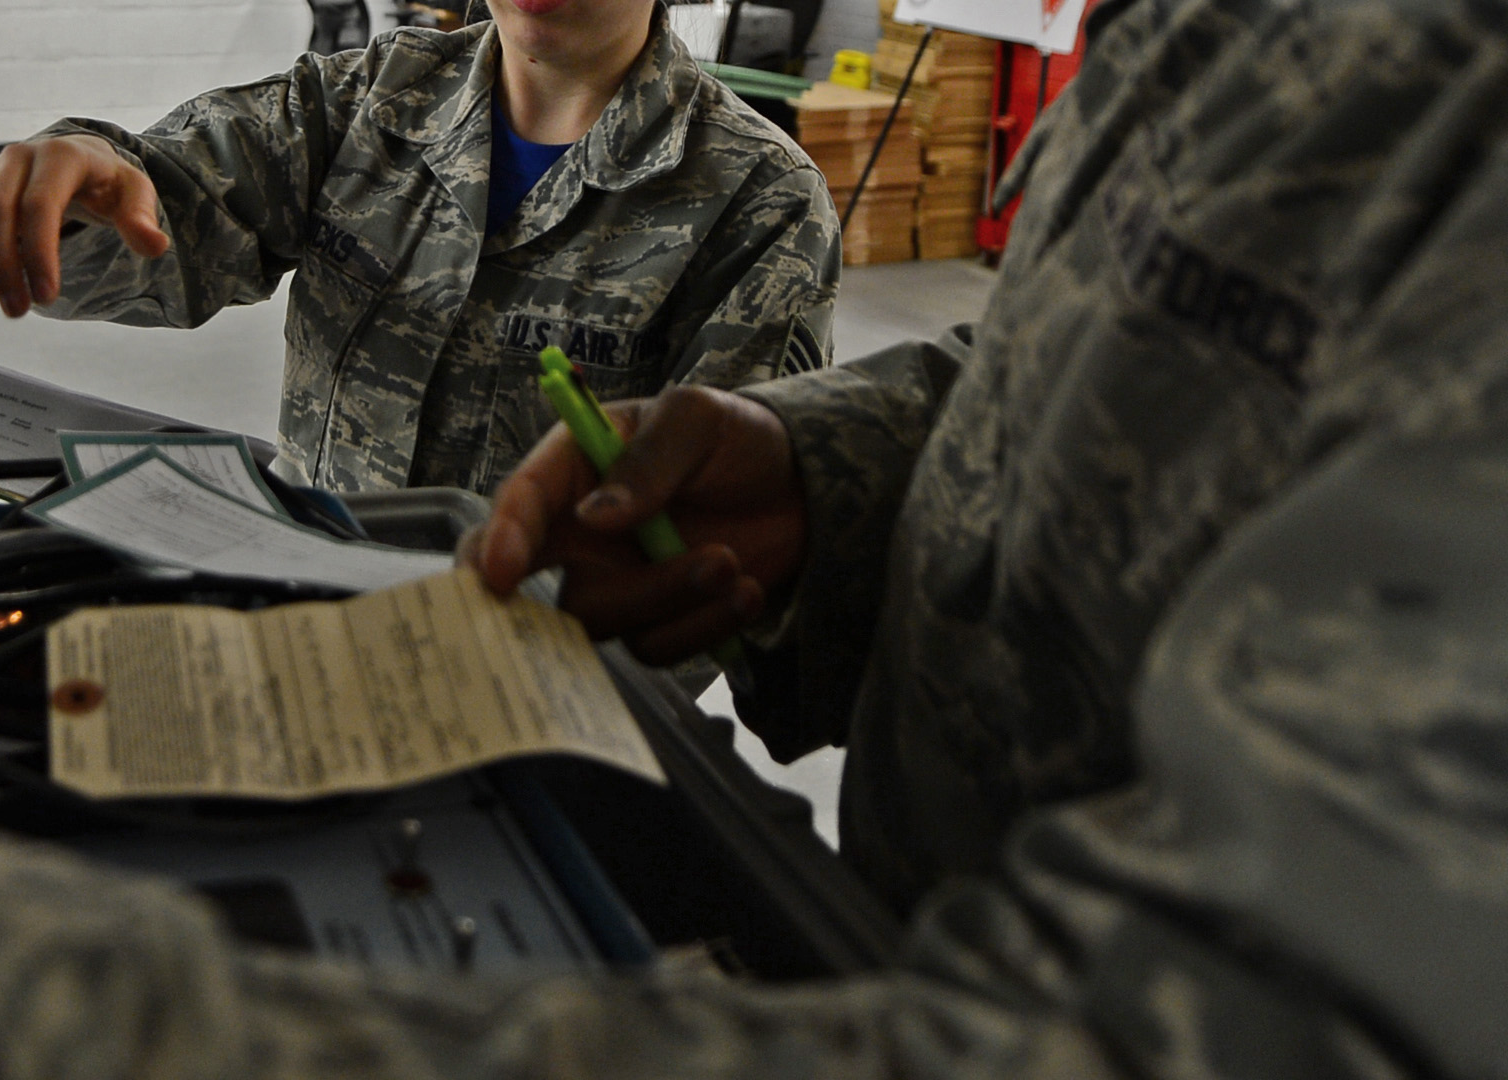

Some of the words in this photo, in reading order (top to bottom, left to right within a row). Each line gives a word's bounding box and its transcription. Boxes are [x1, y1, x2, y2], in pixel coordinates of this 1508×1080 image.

[309, 218, 358, 262] CKS
[1133, 228, 1318, 394] FORC
[567, 324, 619, 366] AIR
